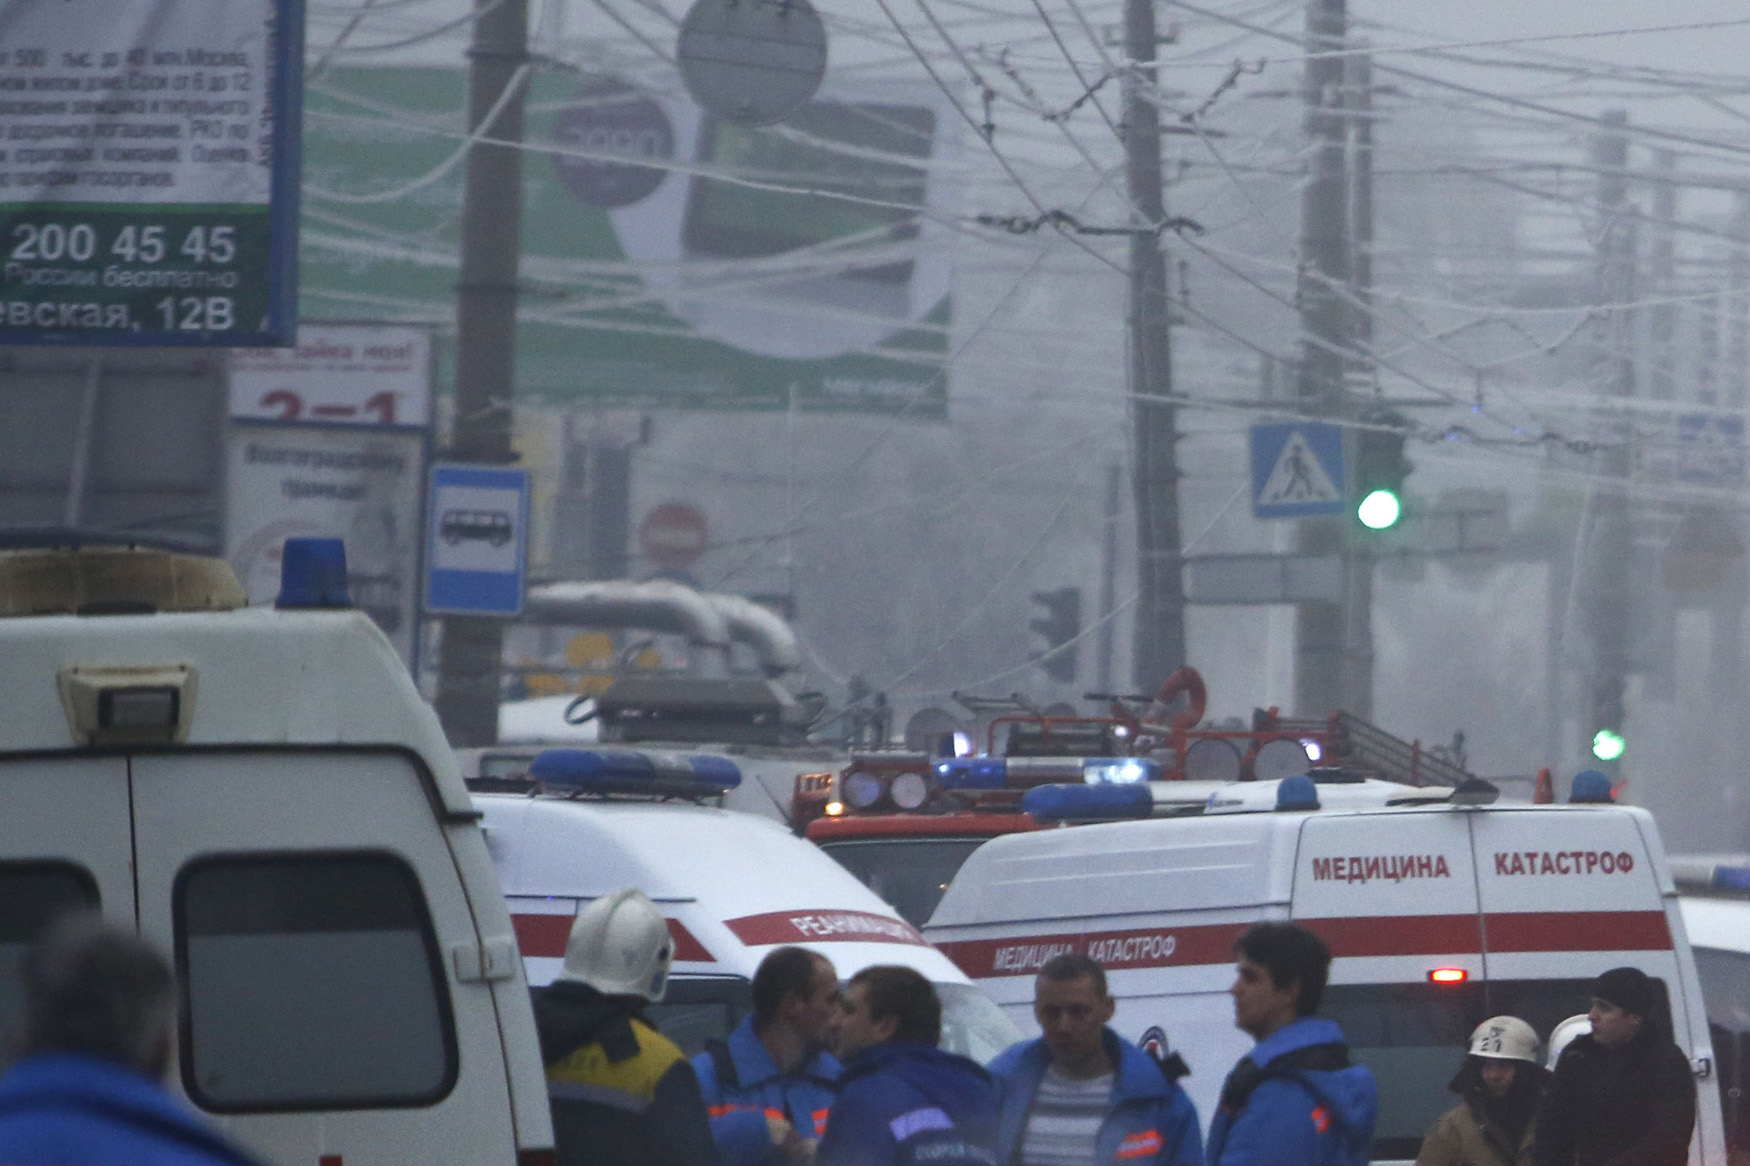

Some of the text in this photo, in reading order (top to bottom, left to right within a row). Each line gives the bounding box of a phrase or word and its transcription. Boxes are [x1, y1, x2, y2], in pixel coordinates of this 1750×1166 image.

[10, 223, 236, 263] 200 45 45
[103, 265, 239, 288] бесплатно
[0, 297, 235, 332] вская, 12В
[1312, 850, 1635, 884] МЕДИЦИНА КАТАСТРОФ
[1088, 934, 1177, 964] КАТАСТРОФ
